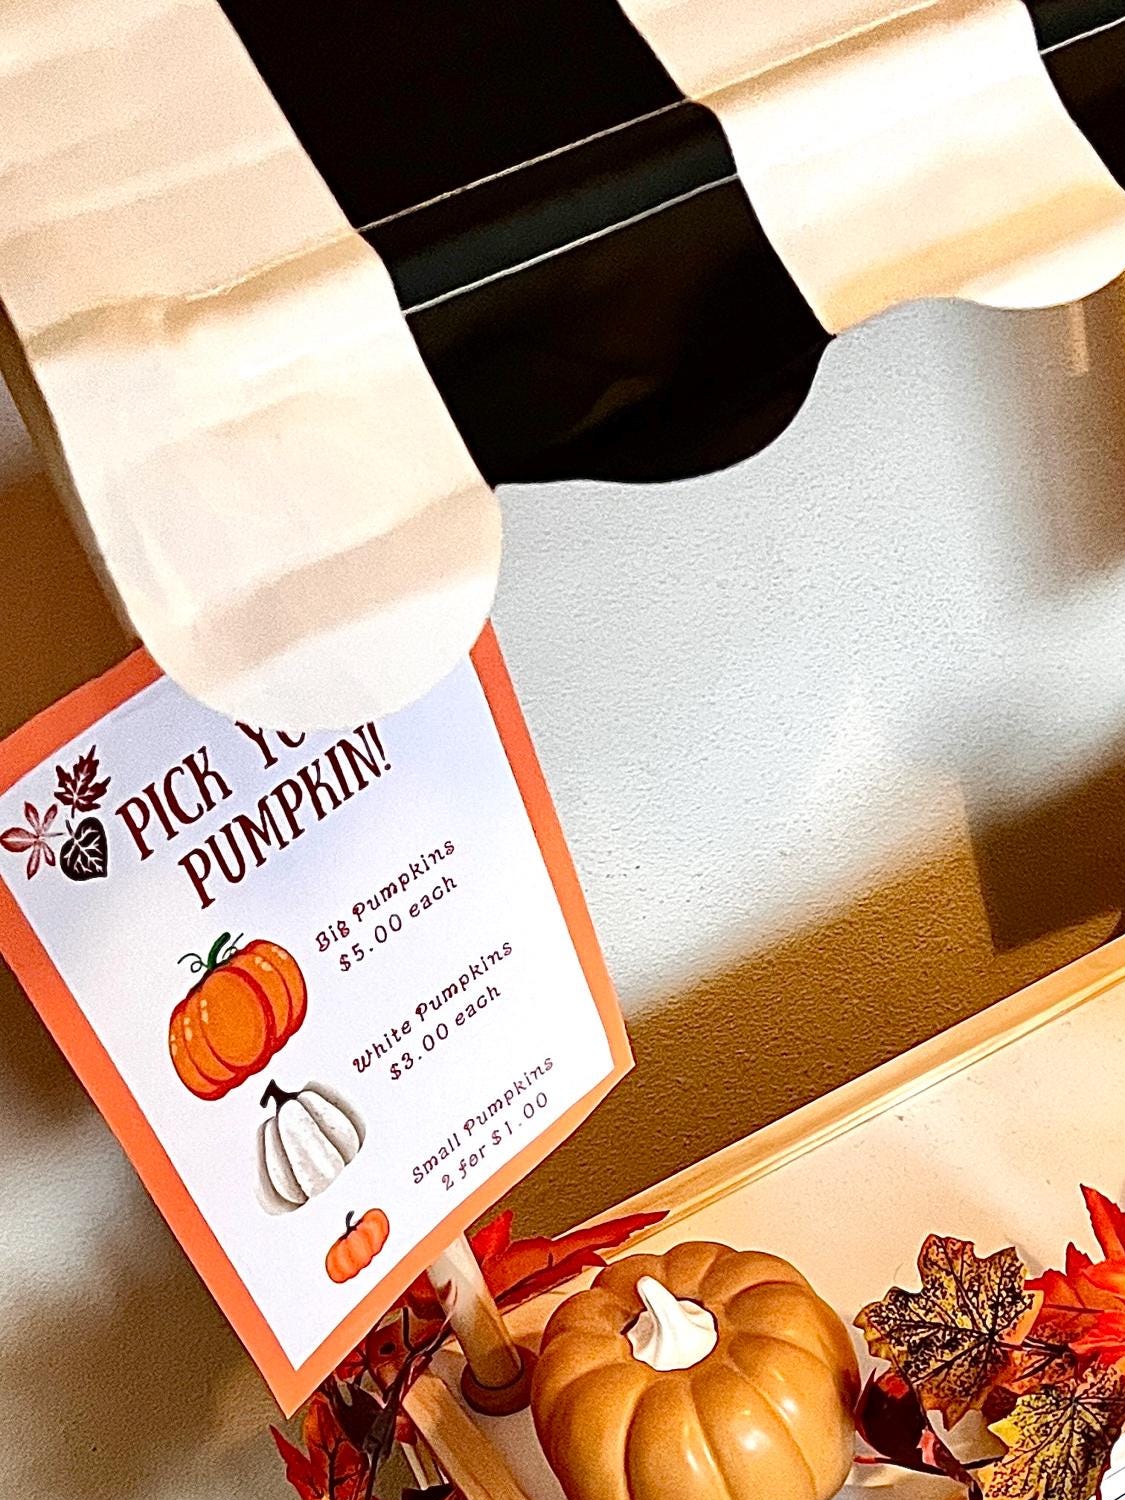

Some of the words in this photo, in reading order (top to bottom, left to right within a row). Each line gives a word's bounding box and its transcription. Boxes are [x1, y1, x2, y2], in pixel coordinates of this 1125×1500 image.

[114, 745, 233, 861] PICK
[177, 721, 391, 909] PUMPKIN!
[315, 919, 350, 952] Big
[352, 840, 455, 922] Pumpkins
[339, 914, 402, 972] $5.00
[409, 876, 457, 918] each
[352, 1020, 412, 1073] White
[415, 942, 513, 1022] Pumpkins
[390, 1023, 448, 1080] $3.00
[455, 985, 501, 1026] each
[412, 1133, 461, 1184] Small
[464, 1058, 553, 1136] Pumpkins
[441, 1174, 455, 1191] 2
[458, 1144, 486, 1179] for
[491, 1092, 547, 1145] $1.00
